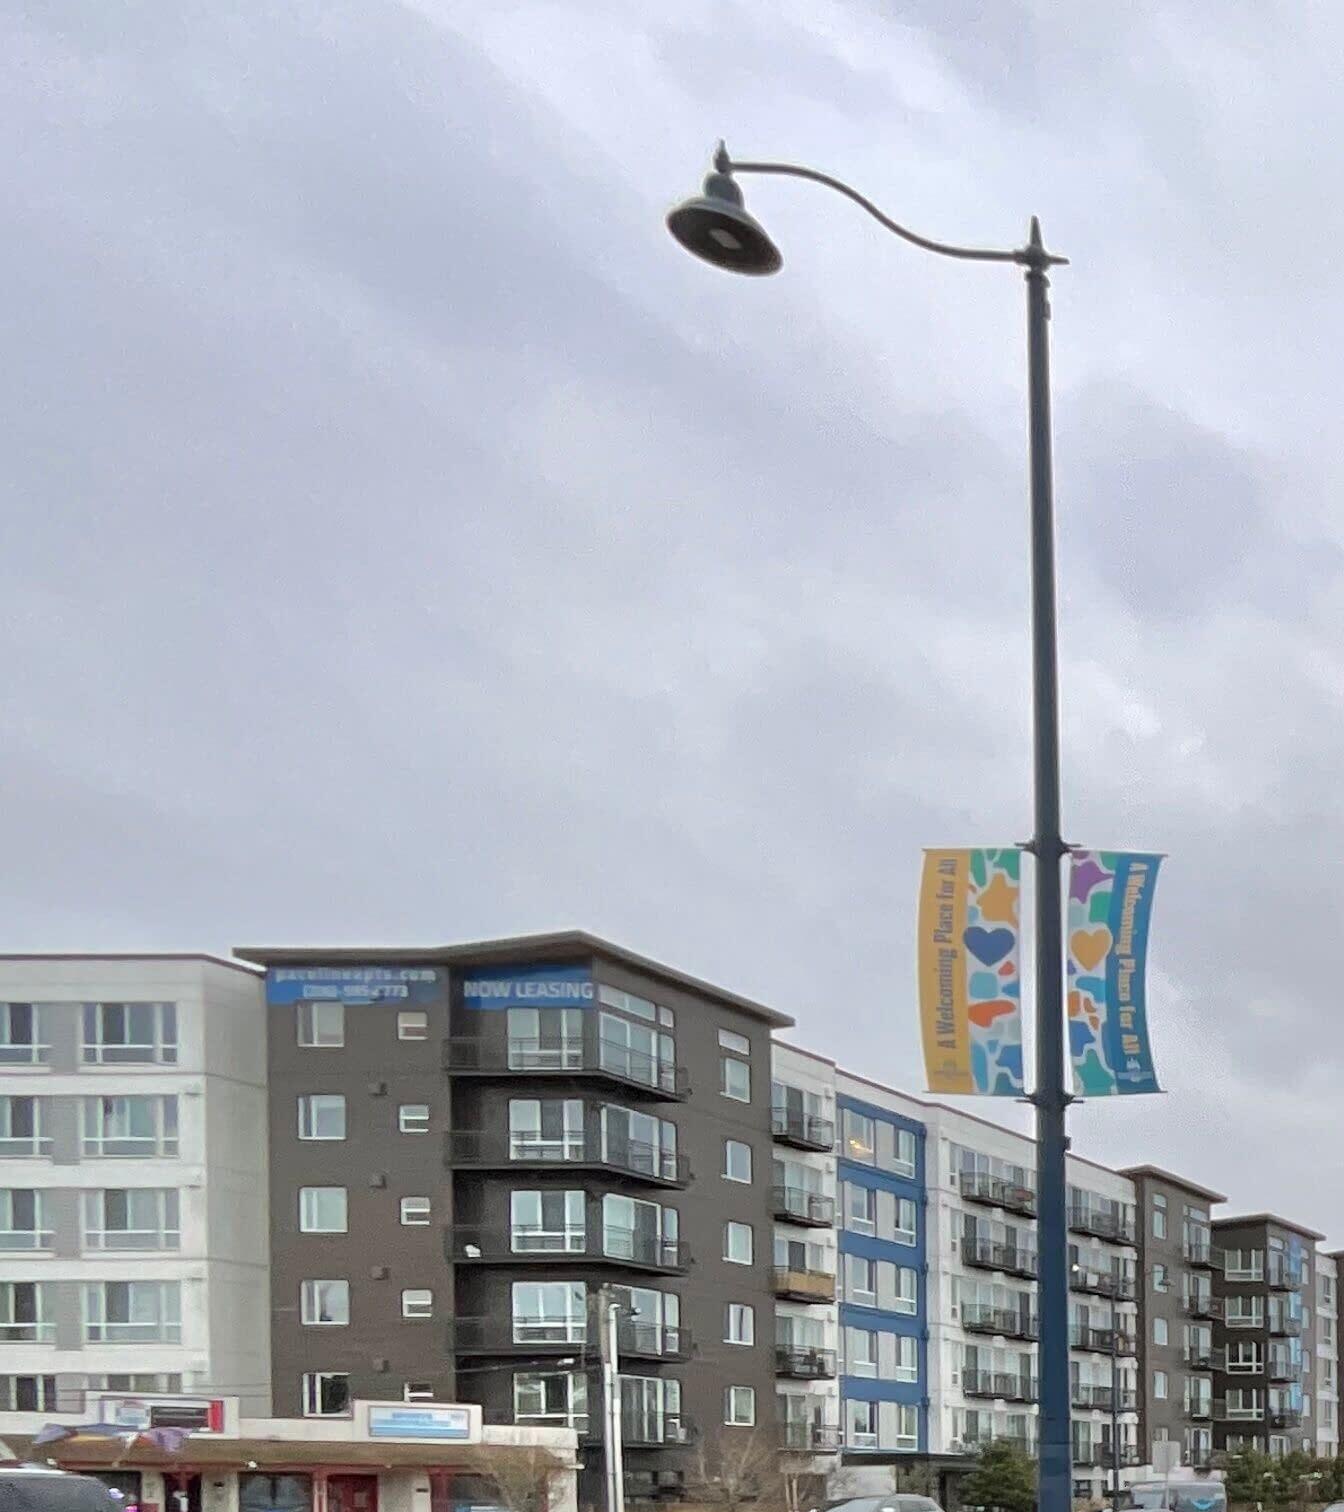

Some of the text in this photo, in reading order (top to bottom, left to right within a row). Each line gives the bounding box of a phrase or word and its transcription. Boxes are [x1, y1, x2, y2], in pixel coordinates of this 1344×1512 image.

[463, 980, 593, 999] NOW LEASING
[933, 858, 957, 1049] A Welcoming Place for All
[1115, 861, 1148, 1055] A Welcoming Place for All
